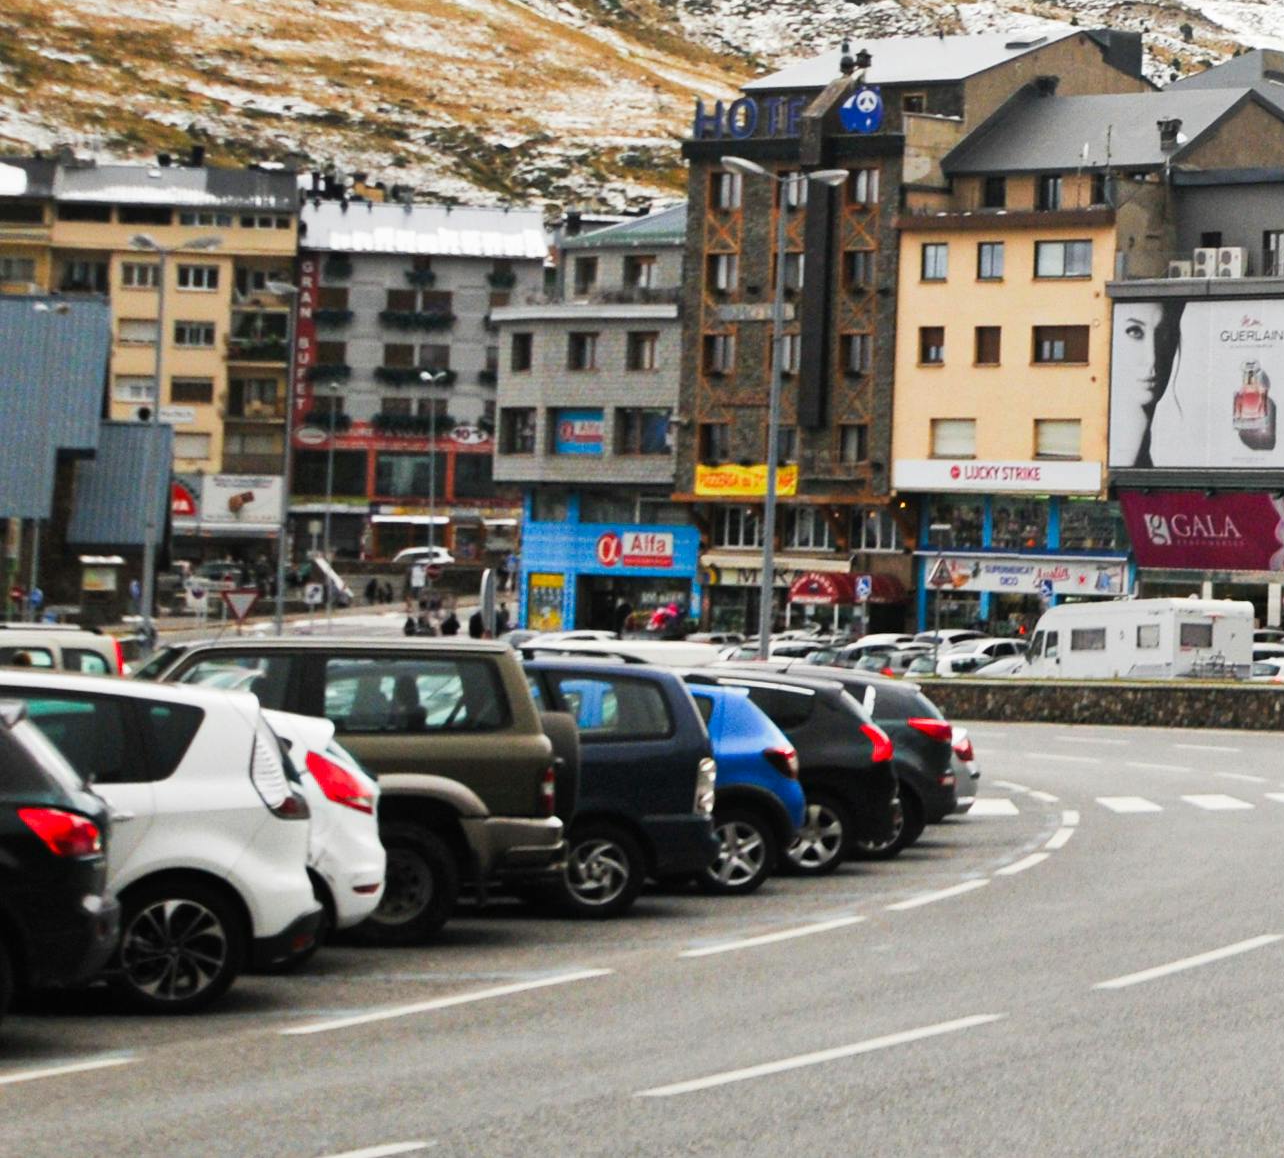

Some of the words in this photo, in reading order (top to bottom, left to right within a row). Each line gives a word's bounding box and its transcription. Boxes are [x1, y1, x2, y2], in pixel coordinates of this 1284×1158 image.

[692, 95, 807, 139] HOTE
[300, 261, 314, 318] GRAN
[1220, 329, 1284, 343] GUERLAIN
[964, 465, 1000, 480] LUCKY
[1002, 466, 1041, 481] STRIKE
[1170, 514, 1243, 539] GALA
[630, 533, 667, 553] Alfa
